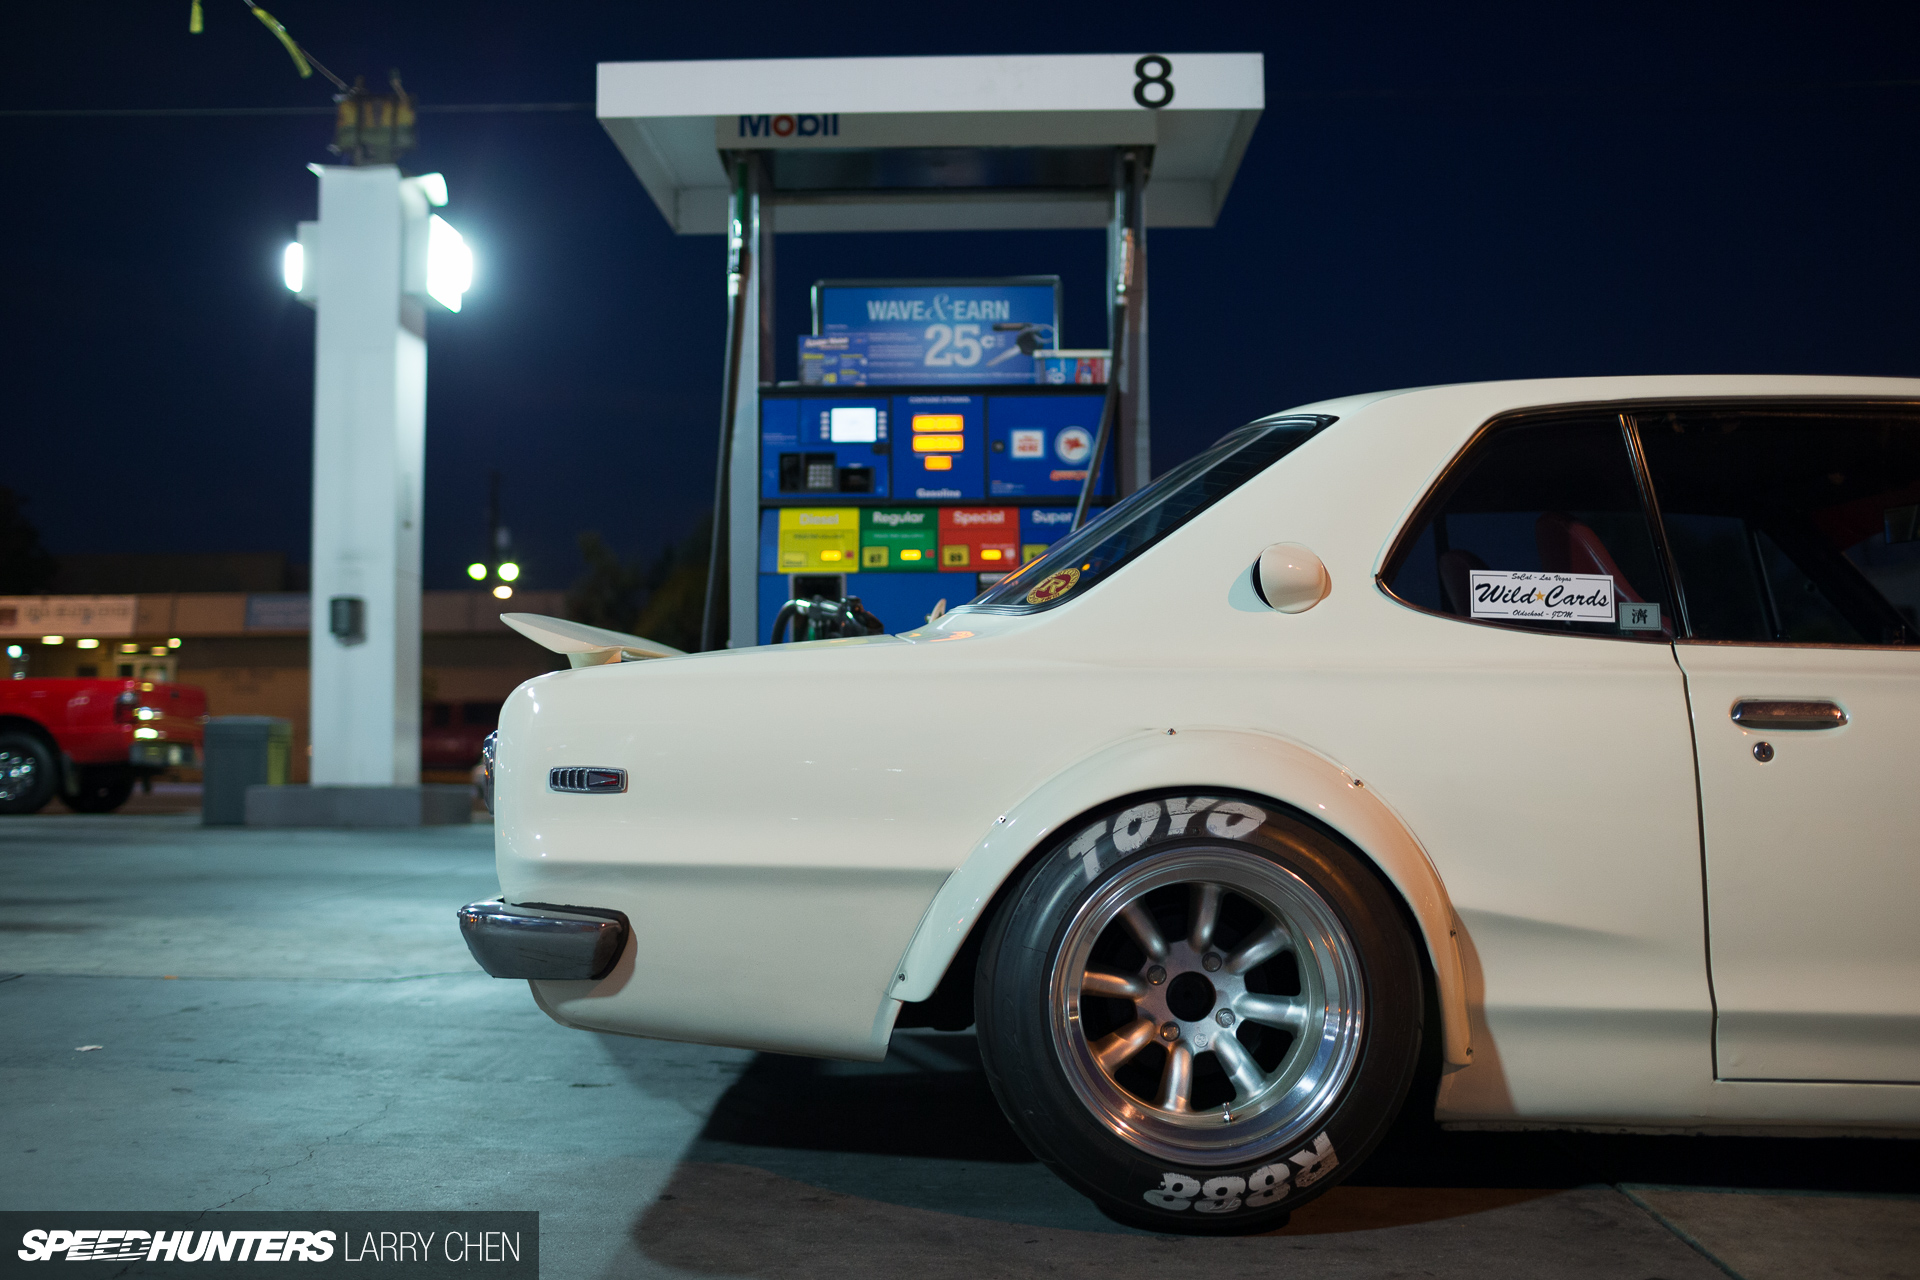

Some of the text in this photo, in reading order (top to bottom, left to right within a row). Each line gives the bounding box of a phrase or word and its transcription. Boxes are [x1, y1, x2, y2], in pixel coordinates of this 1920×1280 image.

[1133, 53, 1175, 110] 8
[867, 300, 925, 321] WAVE
[953, 300, 1010, 320] EARN
[915, 487, 962, 499] Gasoline
[799, 513, 840, 526] Diesel
[872, 511, 926, 527] Regular
[953, 510, 1006, 526] Special
[1032, 509, 1074, 526] Super
[1511, 572, 1533, 581] SoCal
[1539, 573, 1552, 581] Las
[1553, 574, 1573, 584] Vegas
[1474, 582, 1610, 608] Wild Cards
[1512, 609, 1545, 617] Oldschool
[1551, 610, 1575, 620] JDM
[1068, 796, 1267, 881] TOYO
[1142, 1130, 1340, 1214] R888
